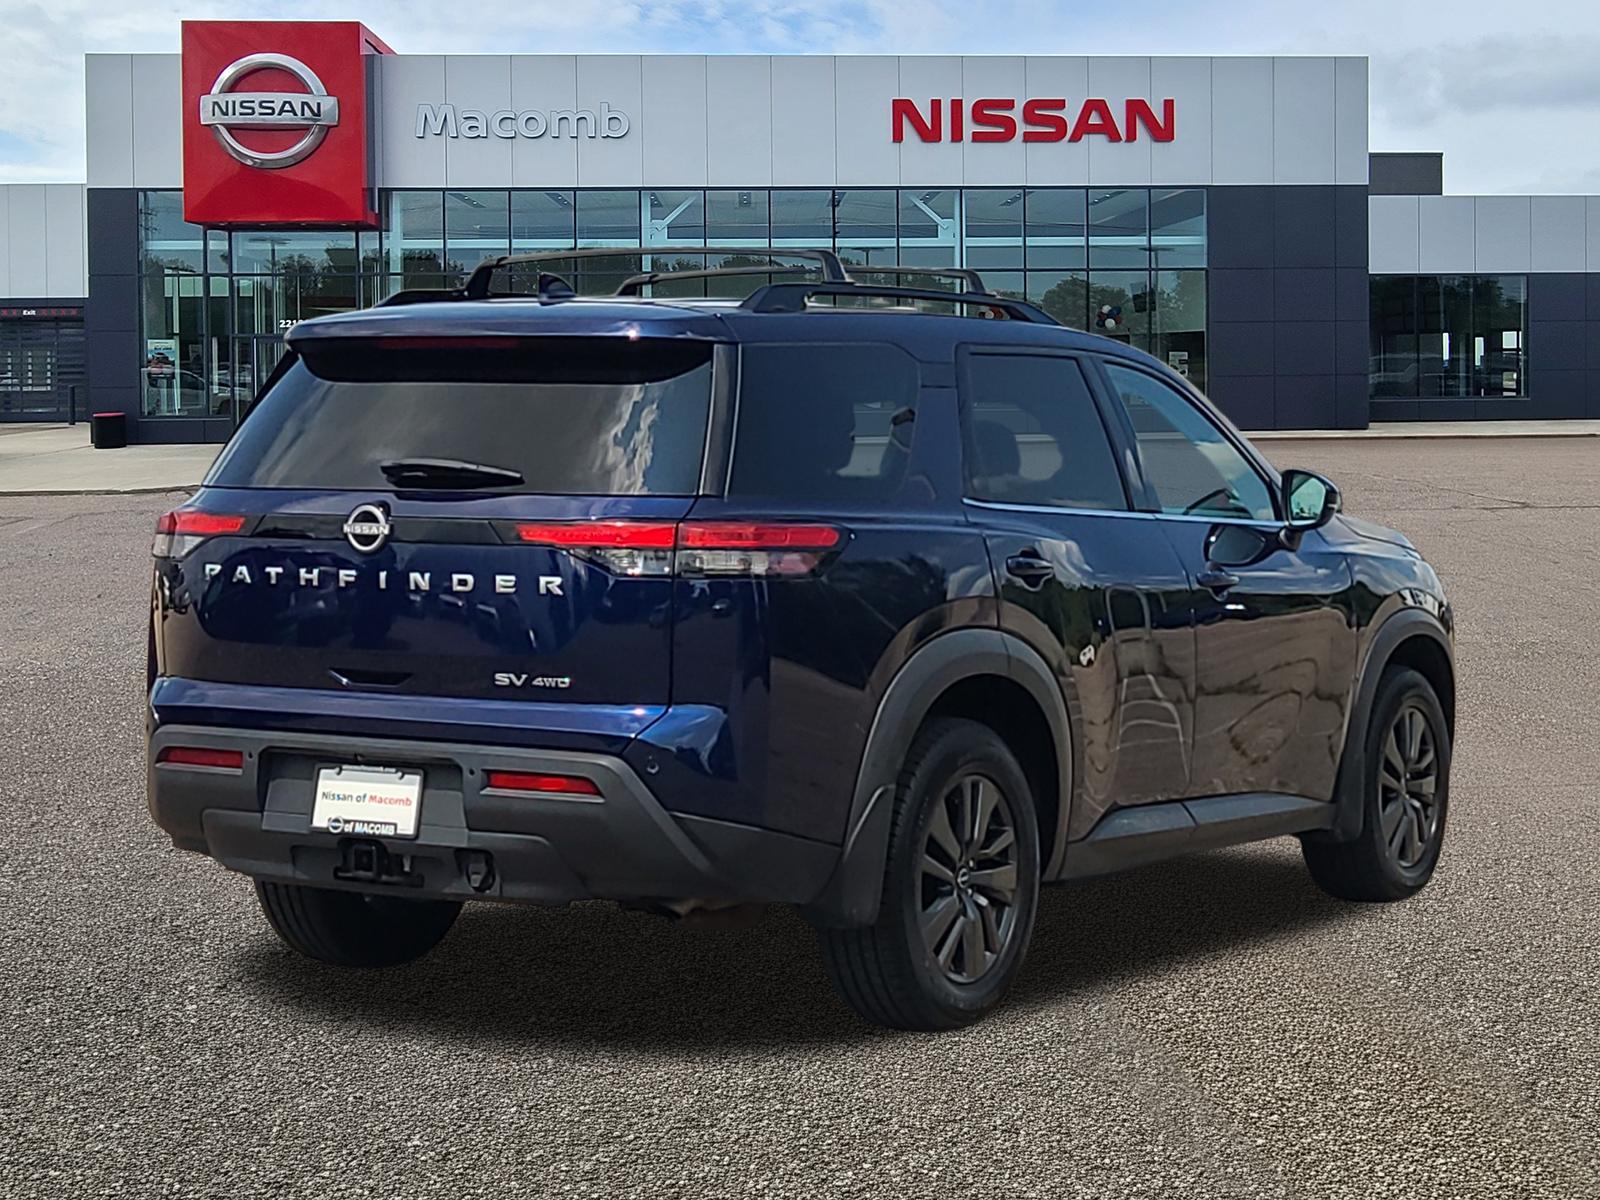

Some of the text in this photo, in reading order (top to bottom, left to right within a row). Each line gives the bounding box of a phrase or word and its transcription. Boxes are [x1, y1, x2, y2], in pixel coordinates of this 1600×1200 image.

[212, 100, 321, 117] NISSAN
[415, 102, 630, 138] Macomb
[892, 98, 1175, 142] NISSAN
[343, 523, 390, 535] NISSAN
[204, 563, 564, 596] PATHFINDER
[494, 672, 570, 688] SV 4WD
[321, 791, 412, 807] Nissan of Macomb
[343, 822, 396, 835] of MACOMB
